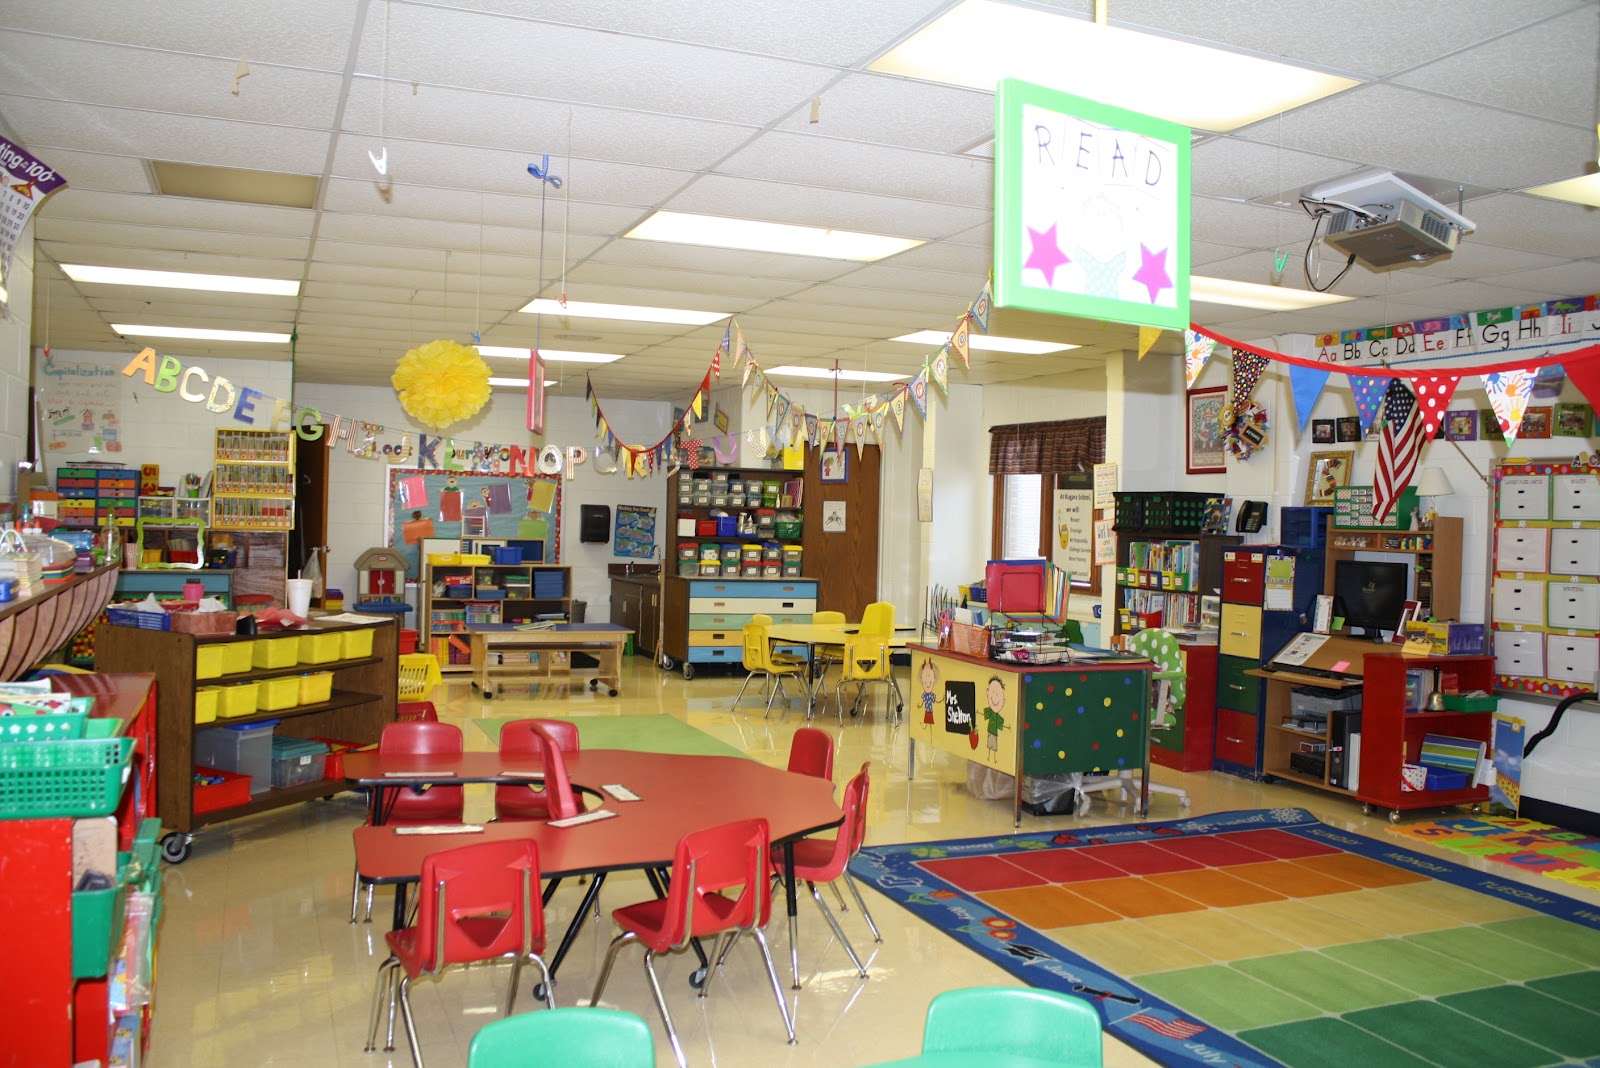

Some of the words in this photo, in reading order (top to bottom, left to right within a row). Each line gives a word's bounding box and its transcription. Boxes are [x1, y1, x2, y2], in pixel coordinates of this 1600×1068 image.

[1034, 124, 1162, 187] READ
[25, 161, 53, 182] 100
[23, 201, 30, 210] 10
[1317, 347, 1337, 362] Aa
[1343, 342, 1360, 360] Bb
[1369, 340, 1388, 357] Cc
[1396, 335, 1415, 355] Dd
[1423, 332, 1444, 352] Ee
[1456, 327, 1472, 347] Ff
[1482, 324, 1509, 350] Gg
[1519, 317, 1541, 340] Hh
[1561, 313, 1572, 334] Ii
[947, 706, 972, 724] Shelton
[1216, 813, 1266, 826] January
[1306, 829, 1364, 846] SUNDAY
[1383, 853, 1453, 873] MONDAY
[1478, 880, 1556, 905] TUESDAY
[947, 906, 976, 921] May
[1044, 964, 1082, 984] June
[1184, 1043, 1227, 1065] July
